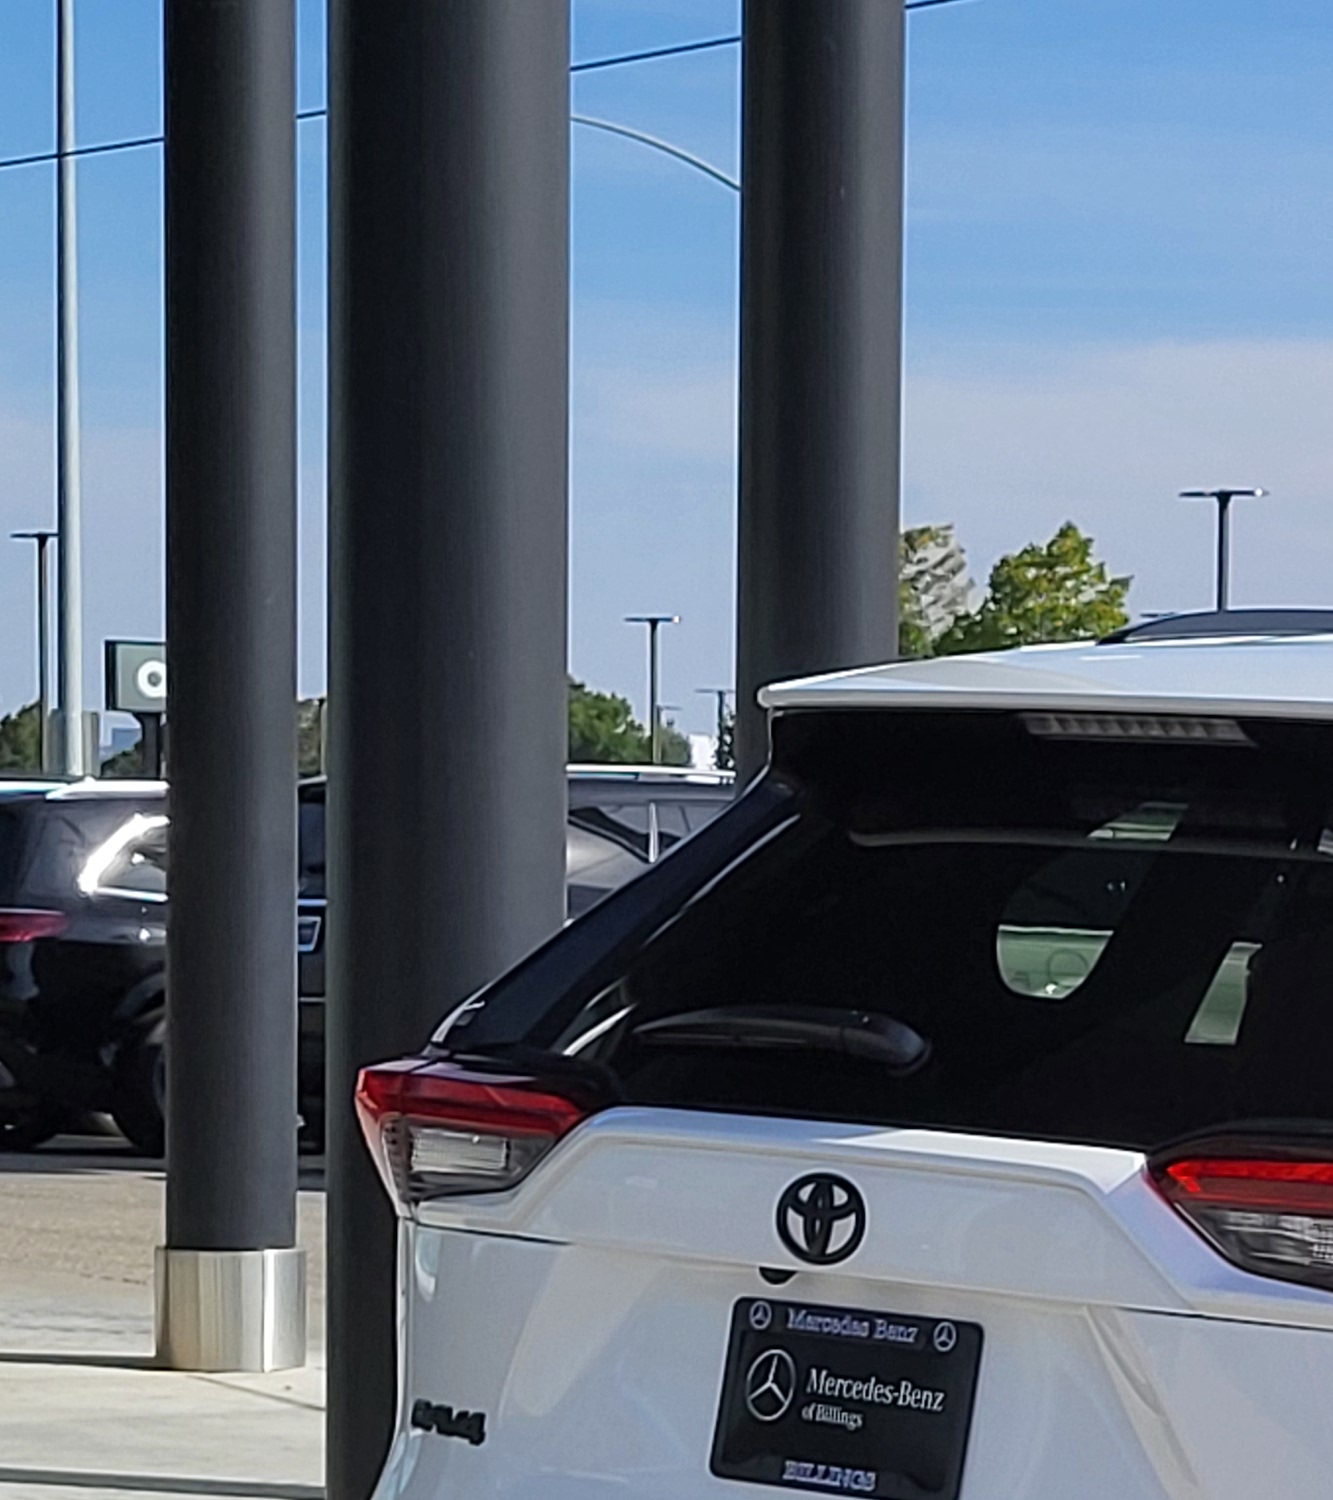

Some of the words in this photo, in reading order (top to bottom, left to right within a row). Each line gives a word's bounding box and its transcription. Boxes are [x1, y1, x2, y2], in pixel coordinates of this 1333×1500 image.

[787, 1307, 870, 1338] Mercedes
[873, 1318, 919, 1343] Benz
[806, 1367, 945, 1412] Mercedes-Benz
[801, 1402, 816, 1421] of
[815, 1403, 863, 1431] Billings
[782, 1460, 876, 1491] BILLINGS
